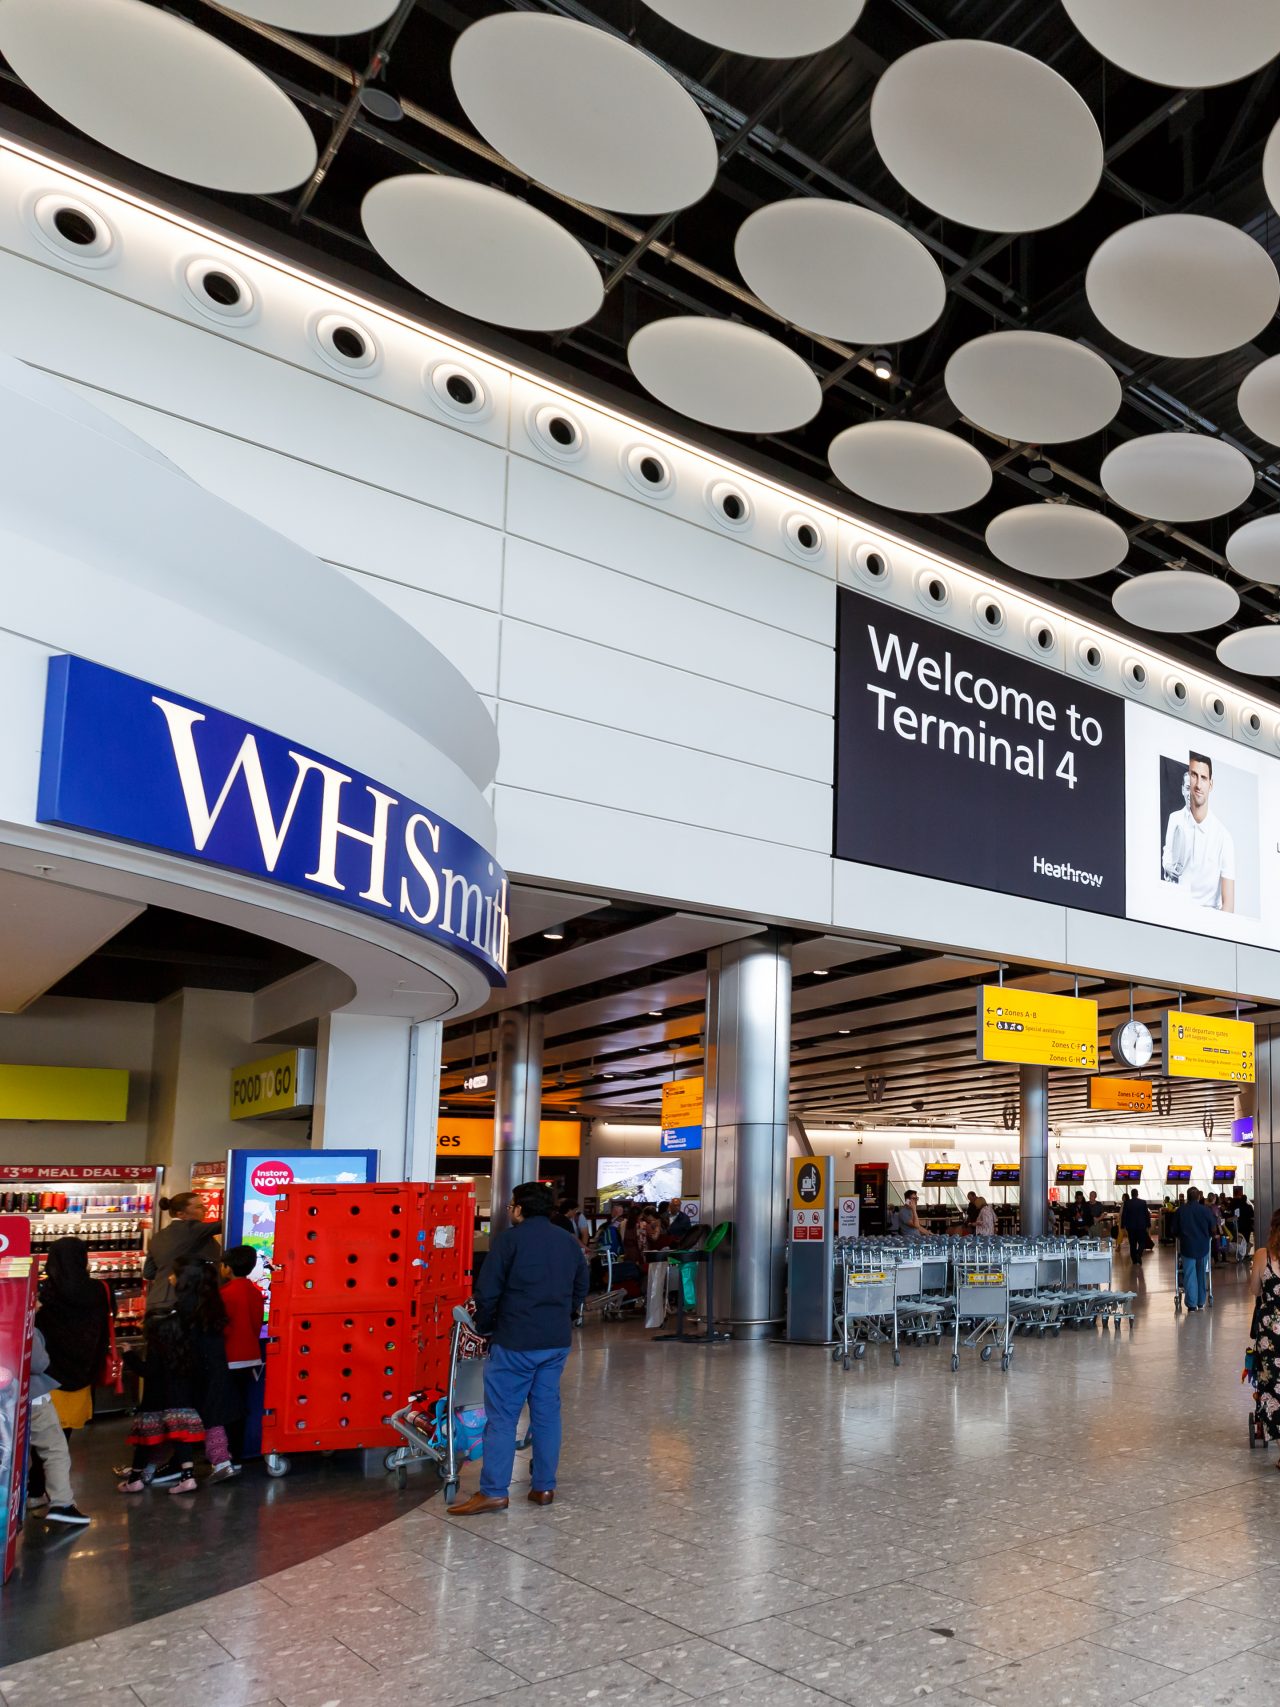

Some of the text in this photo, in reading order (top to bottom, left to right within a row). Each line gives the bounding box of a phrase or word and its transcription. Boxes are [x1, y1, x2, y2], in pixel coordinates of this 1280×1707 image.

[867, 624, 1103, 747] Welcome to
[866, 683, 1078, 789] Terminal 4
[151, 695, 510, 975] WHSmith
[1033, 855, 1103, 888] Heathrow
[1004, 1009, 1024, 1018] Zones
[1051, 1041, 1070, 1049] Zones
[1049, 1054, 1068, 1063] Zones
[437, 1133, 461, 1147] es
[38, 1168, 78, 1178] MEAL
[83, 1168, 121, 1178] DEAL
[254, 1177, 292, 1188] NOW
